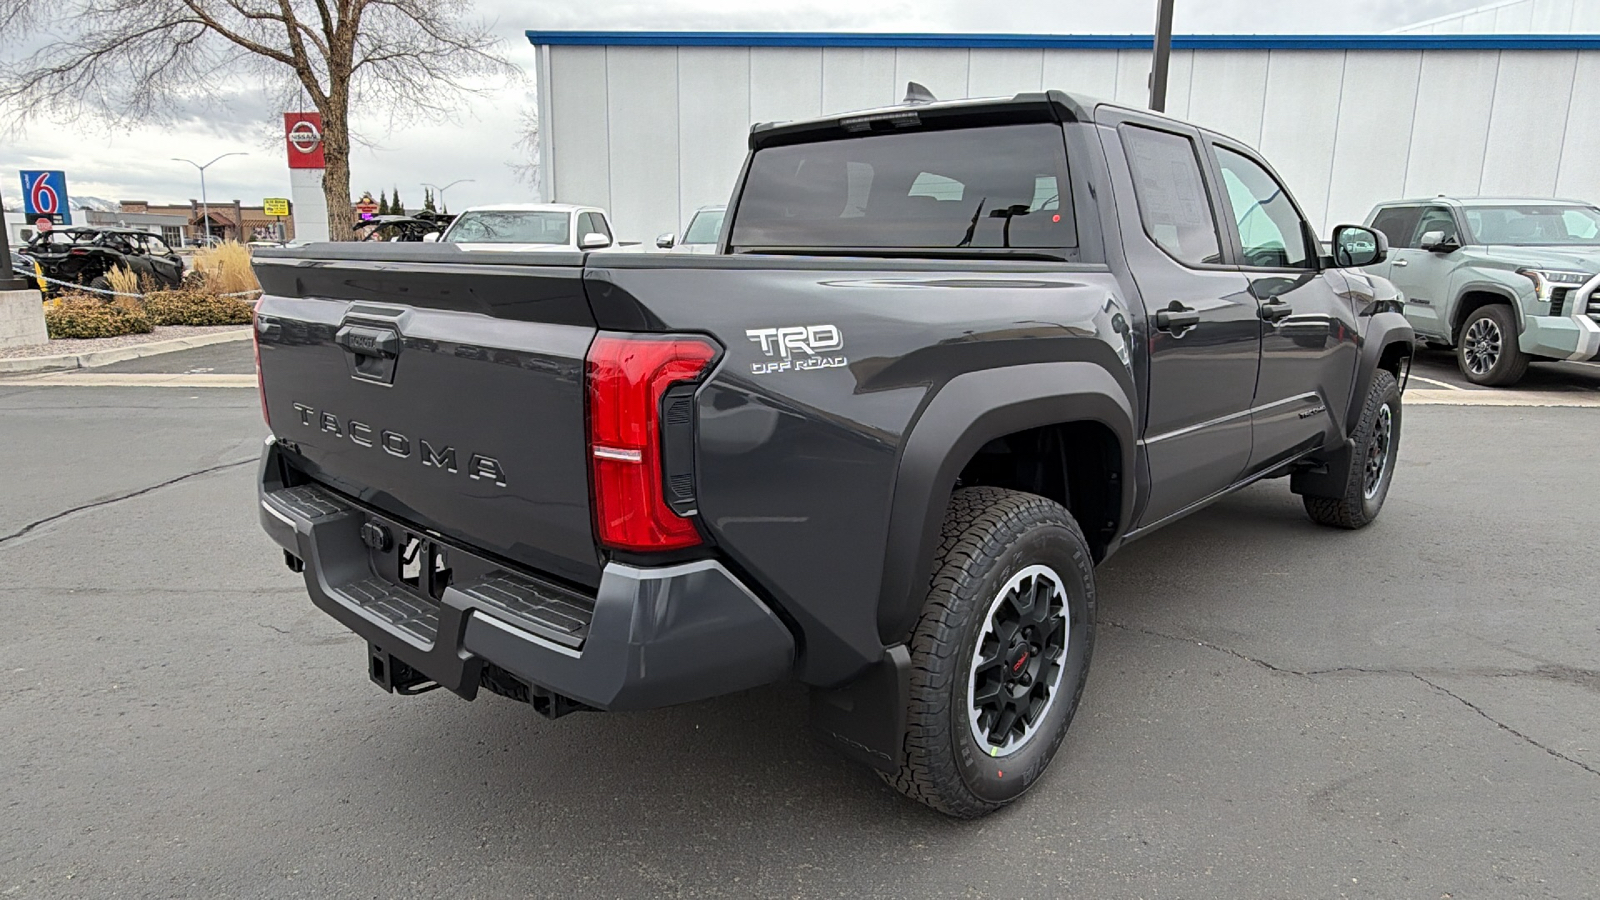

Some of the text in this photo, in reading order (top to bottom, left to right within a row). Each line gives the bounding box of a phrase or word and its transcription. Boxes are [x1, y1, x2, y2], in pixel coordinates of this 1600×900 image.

[32, 172, 58, 213] 6
[745, 324, 844, 361] TRD
[750, 356, 848, 375] OFF ROAD
[293, 401, 507, 488] TACOMA
